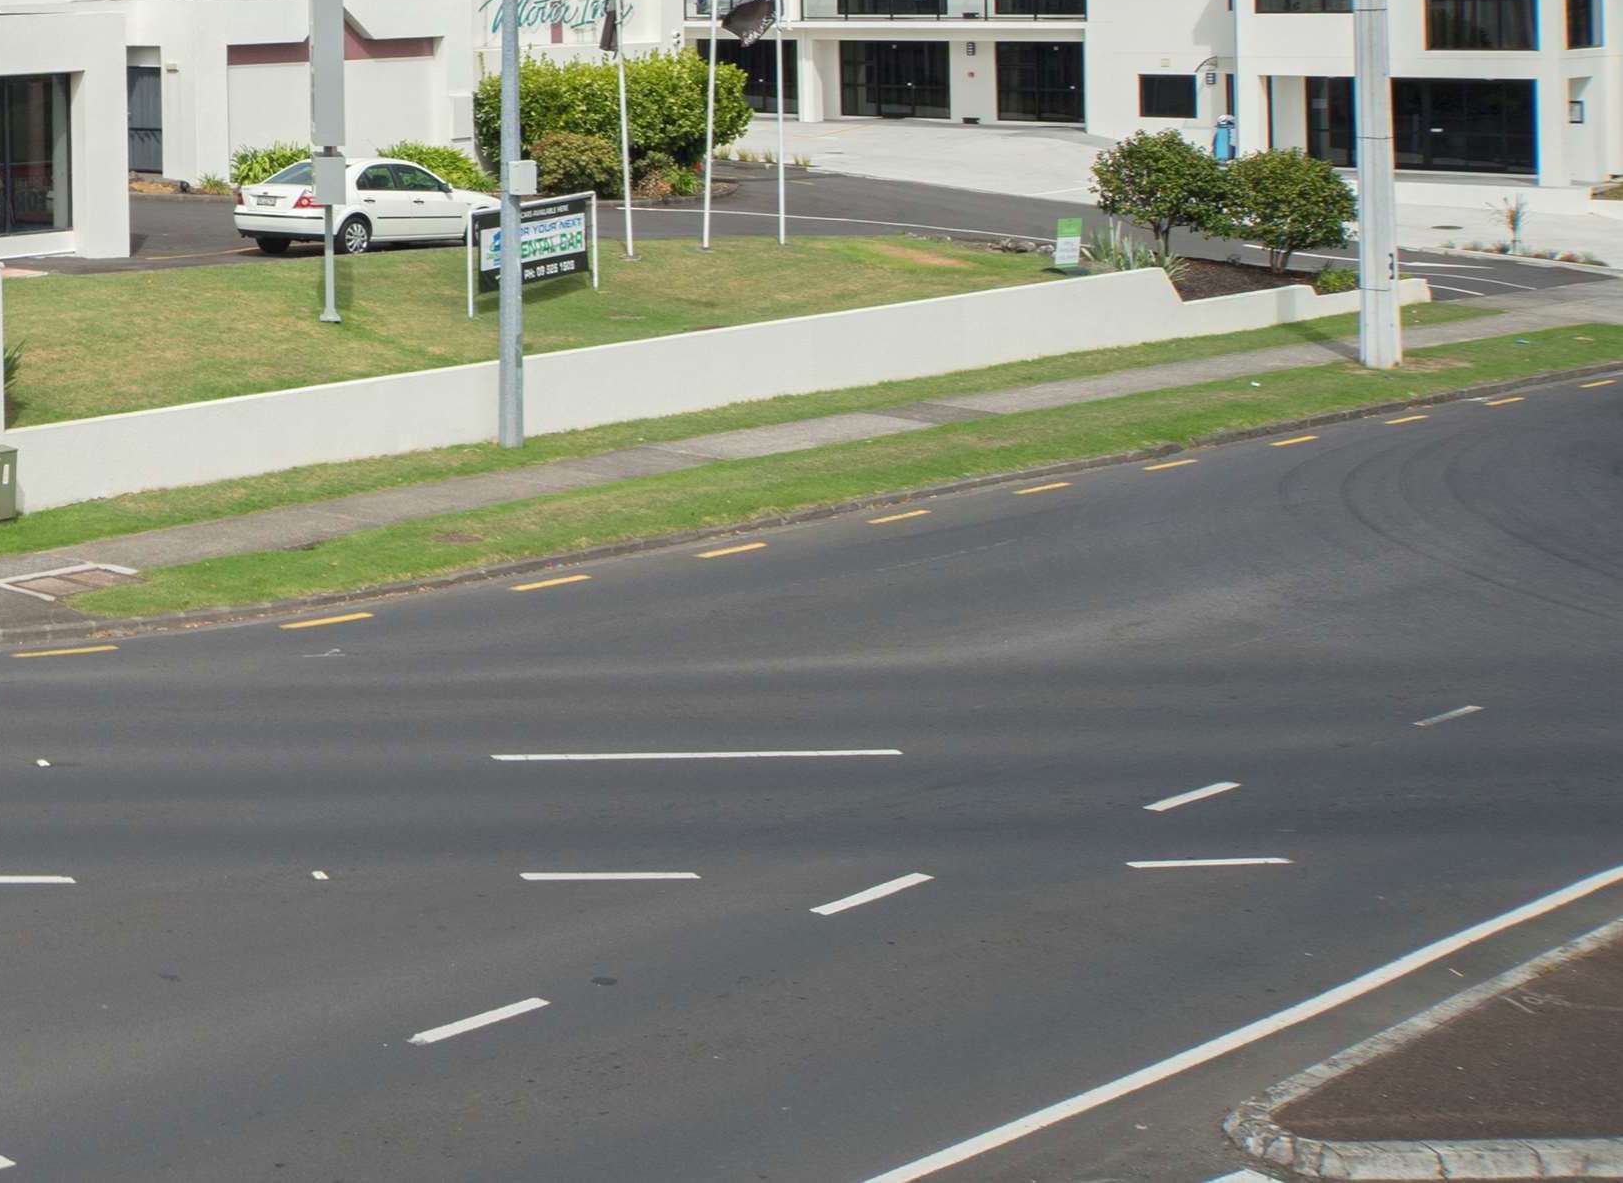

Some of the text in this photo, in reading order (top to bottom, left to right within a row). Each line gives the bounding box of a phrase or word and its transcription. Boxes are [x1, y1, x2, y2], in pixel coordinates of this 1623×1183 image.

[532, 222, 557, 235] YOUR
[558, 217, 581, 229] NEXT
[520, 230, 583, 258] ENTAL CAR
